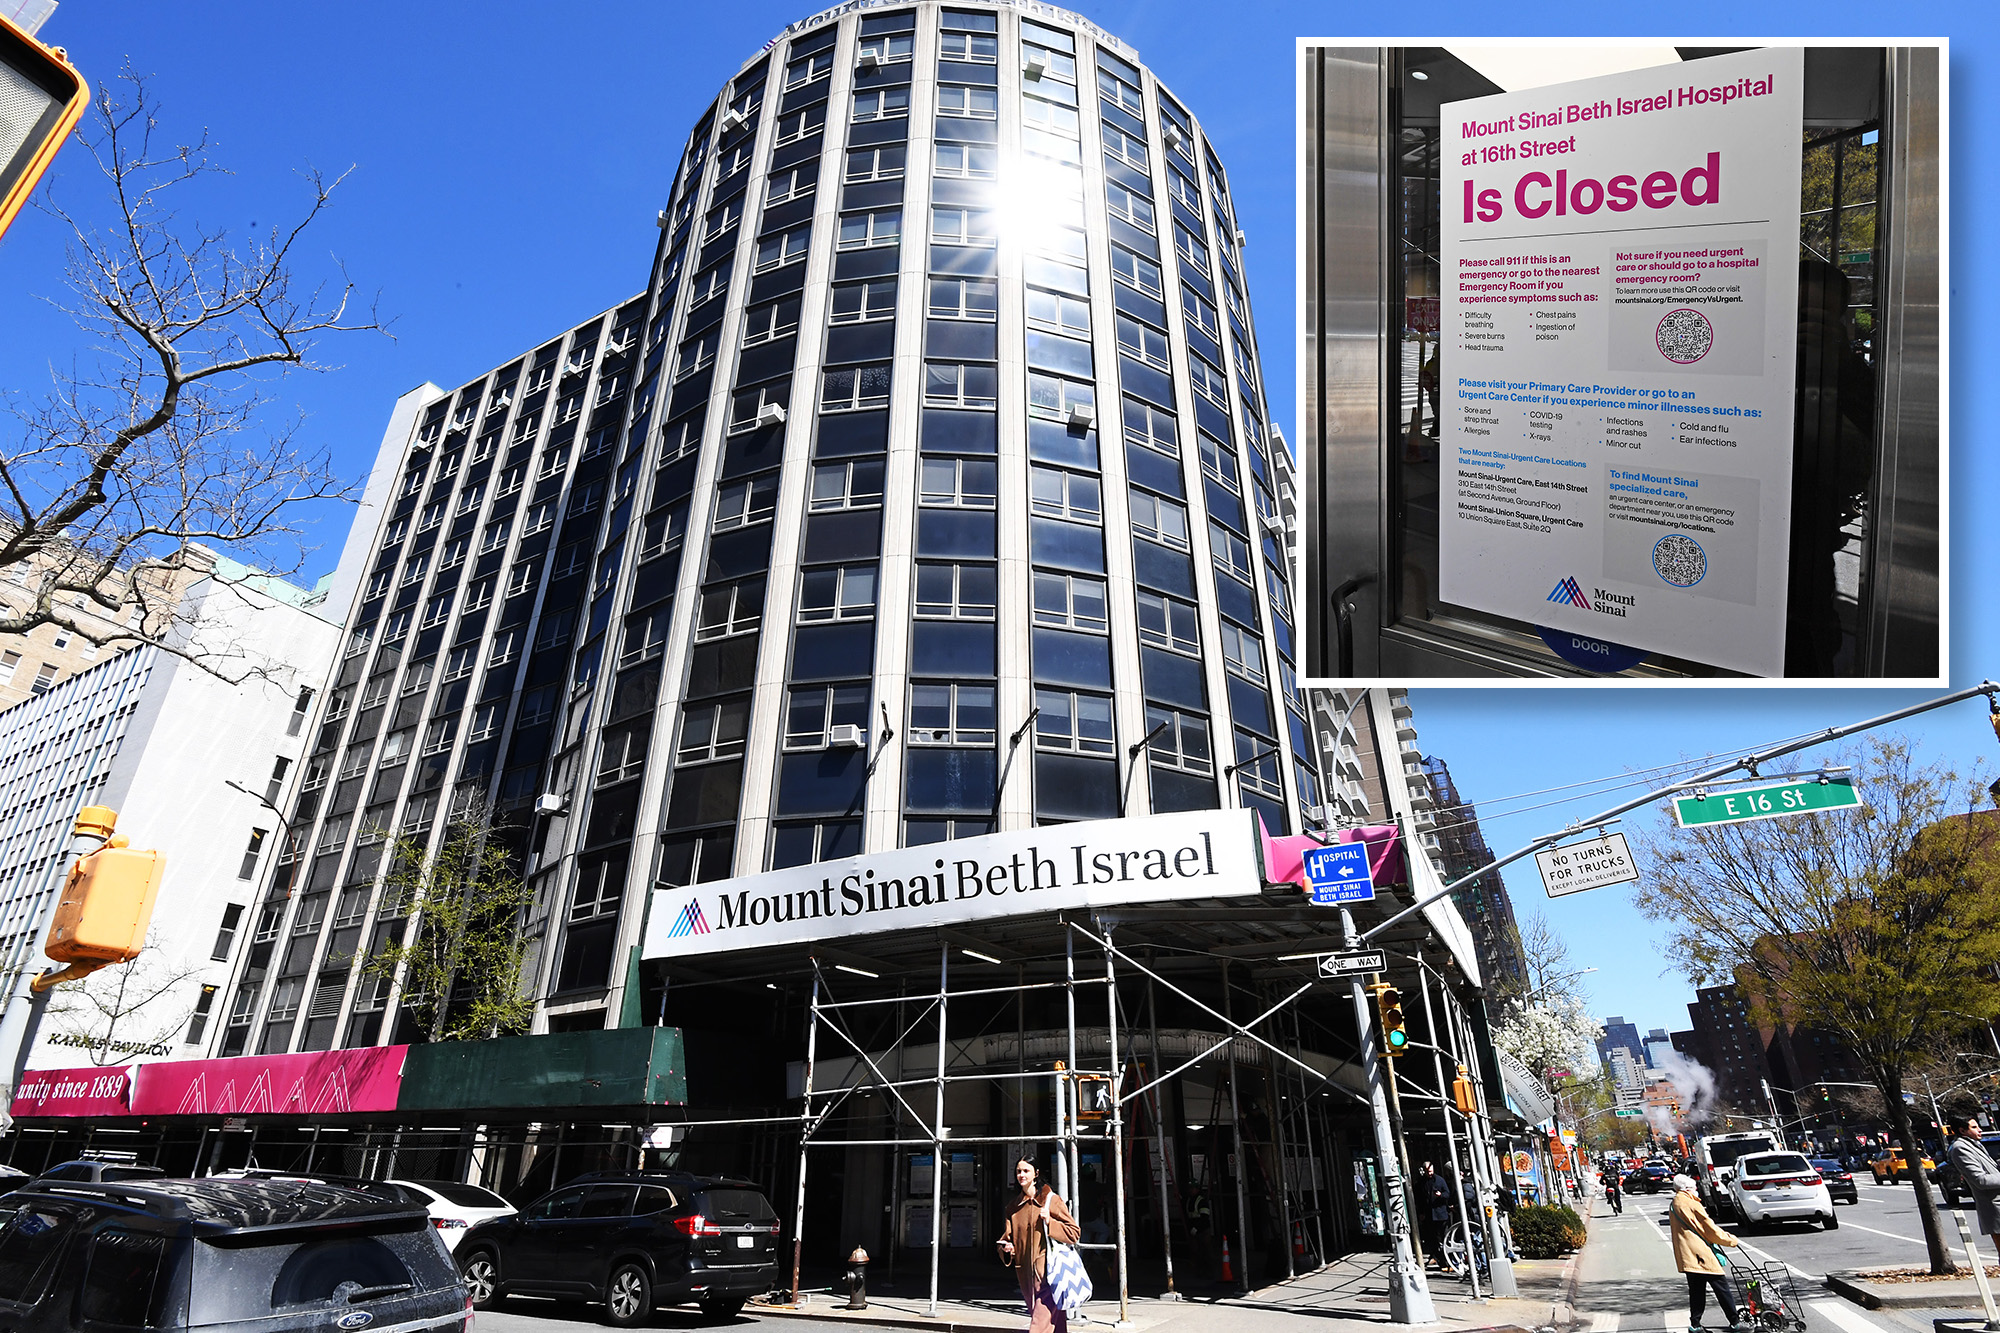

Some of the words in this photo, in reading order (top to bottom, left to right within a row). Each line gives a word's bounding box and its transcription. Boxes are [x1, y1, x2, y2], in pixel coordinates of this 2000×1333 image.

[1461, 116, 1515, 139] Mount
[1518, 107, 1563, 131] Sinai
[1567, 100, 1612, 124] Beth
[1616, 90, 1672, 116] Israel
[1678, 74, 1773, 107] Hospital
[1461, 148, 1476, 166] at
[1481, 143, 1516, 163] 16th
[1520, 135, 1576, 159] Street
[1463, 179, 1502, 224] Is
[1514, 151, 1720, 219] Closed
[1616, 252, 1632, 261] Not
[1656, 251, 1663, 259] if
[1664, 251, 1681, 260] you
[1683, 249, 1708, 258] need
[1710, 247, 1744, 258] urgent
[1459, 258, 1488, 267] Please
[1490, 257, 1505, 266] call
[1506, 257, 1520, 265] 911
[1522, 256, 1528, 264] if
[1530, 255, 1547, 264] this
[1549, 255, 1557, 263] is
[1558, 255, 1571, 263] an
[1649, 261, 1681, 270] should
[1683, 261, 1695, 270] go
[1697, 260, 1707, 268] to
[1717, 258, 1759, 269] hospital
[1459, 271, 1507, 280] emergency
[1520, 270, 1531, 279] go
[1545, 268, 1560, 276] the
[1562, 266, 1600, 276] nearest
[1615, 276, 1669, 284] emergency
[1669, 273, 1701, 282] room?
[1460, 282, 1508, 292] Emergency
[1510, 281, 1536, 290] Room
[1538, 281, 1544, 289] if
[1546, 282, 1564, 290] you
[1459, 295, 1507, 304] experience
[1509, 294, 1557, 304] symptoms
[1558, 293, 1582, 301] such
[1415, 303, 1436, 313] EXIT
[1413, 316, 1439, 326] ONLY
[1465, 312, 1491, 320] Difficulty
[1557, 311, 1576, 320] pains
[1465, 321, 1494, 329] breathing
[1536, 323, 1567, 332] Ingestion
[1536, 333, 1558, 341] poison
[1459, 378, 1486, 388] Please
[1488, 380, 1506, 389] visit
[1507, 382, 1527, 390] your
[1529, 382, 1565, 394] Primary
[1568, 384, 1591, 394] Care
[1593, 385, 1636, 397] Provider
[1639, 389, 1650, 397] or
[1652, 390, 1666, 399] go
[1668, 389, 1680, 398] to
[1681, 391, 1696, 399] an
[1459, 390, 1487, 400] Urgent
[1488, 392, 1509, 401] Care
[1510, 393, 1540, 403] Center
[1543, 395, 1549, 403] if
[1550, 397, 1568, 406] you
[1570, 398, 1626, 408] experience
[1628, 400, 1659, 411] minor
[1661, 402, 1710, 415] illnesses
[1713, 406, 1742, 416] such
[1743, 409, 1762, 418] as:
[1464, 406, 1479, 414] Sore
[1481, 416, 1499, 424] throat
[1530, 411, 1563, 420] COVID-19
[1606, 417, 1643, 426] Infections
[1464, 427, 1490, 436] Allergies
[1530, 421, 1552, 430] testing
[1680, 422, 1700, 431] Cold
[1701, 424, 1716, 432] and
[1718, 425, 1729, 433] flu
[1530, 433, 1551, 441] X-rays
[1680, 436, 1694, 444] Ear
[1695, 437, 1737, 448] infections
[1606, 439, 1627, 448] Minor
[1458, 470, 1477, 478] Mount
[1478, 472, 1516, 484] Sinai-Urgent
[1517, 478, 1534, 487] Care,
[1535, 480, 1550, 488] East
[1551, 482, 1565, 490] 14th
[1566, 484, 1588, 493] Street
[1610, 470, 1620, 479] To
[1622, 472, 1640, 481] find
[1642, 474, 1672, 485] Mount
[1674, 477, 1698, 487] Sinai
[1609, 482, 1661, 495] specialized
[1664, 489, 1688, 500] care,
[1617, 512, 1628, 520] visit
[1594, 588, 1635, 606] Mount
[1594, 601, 1626, 618] Sinai
[1572, 638, 1610, 655] DOOR
[1724, 798, 1740, 816] E
[1747, 794, 1772, 813] 16
[1781, 788, 1806, 808] St
[1552, 855, 1568, 867] NO
[1573, 845, 1613, 861] TURNS
[1310, 850, 1360, 878] HOSPITAL
[1549, 868, 1573, 881] FOR
[1577, 856, 1625, 875] TRUCKS
[716, 878, 836, 930] Mount
[840, 858, 949, 918] Sinai
[952, 847, 1061, 900] Beth
[1070, 831, 1219, 886] Israel
[1551, 881, 1573, 890] EXCEPT
[1575, 877, 1593, 885] LOCAL
[1596, 868, 1630, 881] DELIVERIES
[1319, 884, 1340, 893] MOUNT
[1343, 883, 1360, 892] SINAI
[1320, 893, 1336, 901] BETH
[1339, 890, 1362, 899] ISRAEL
[1327, 960, 1346, 970] ONE
[1357, 957, 1378, 966] WAY
[15, 1077, 51, 1106] unity
[52, 1076, 88, 1099] since
[89, 1074, 124, 1098] 1889
[1529, 1081, 1550, 1102] STREET
